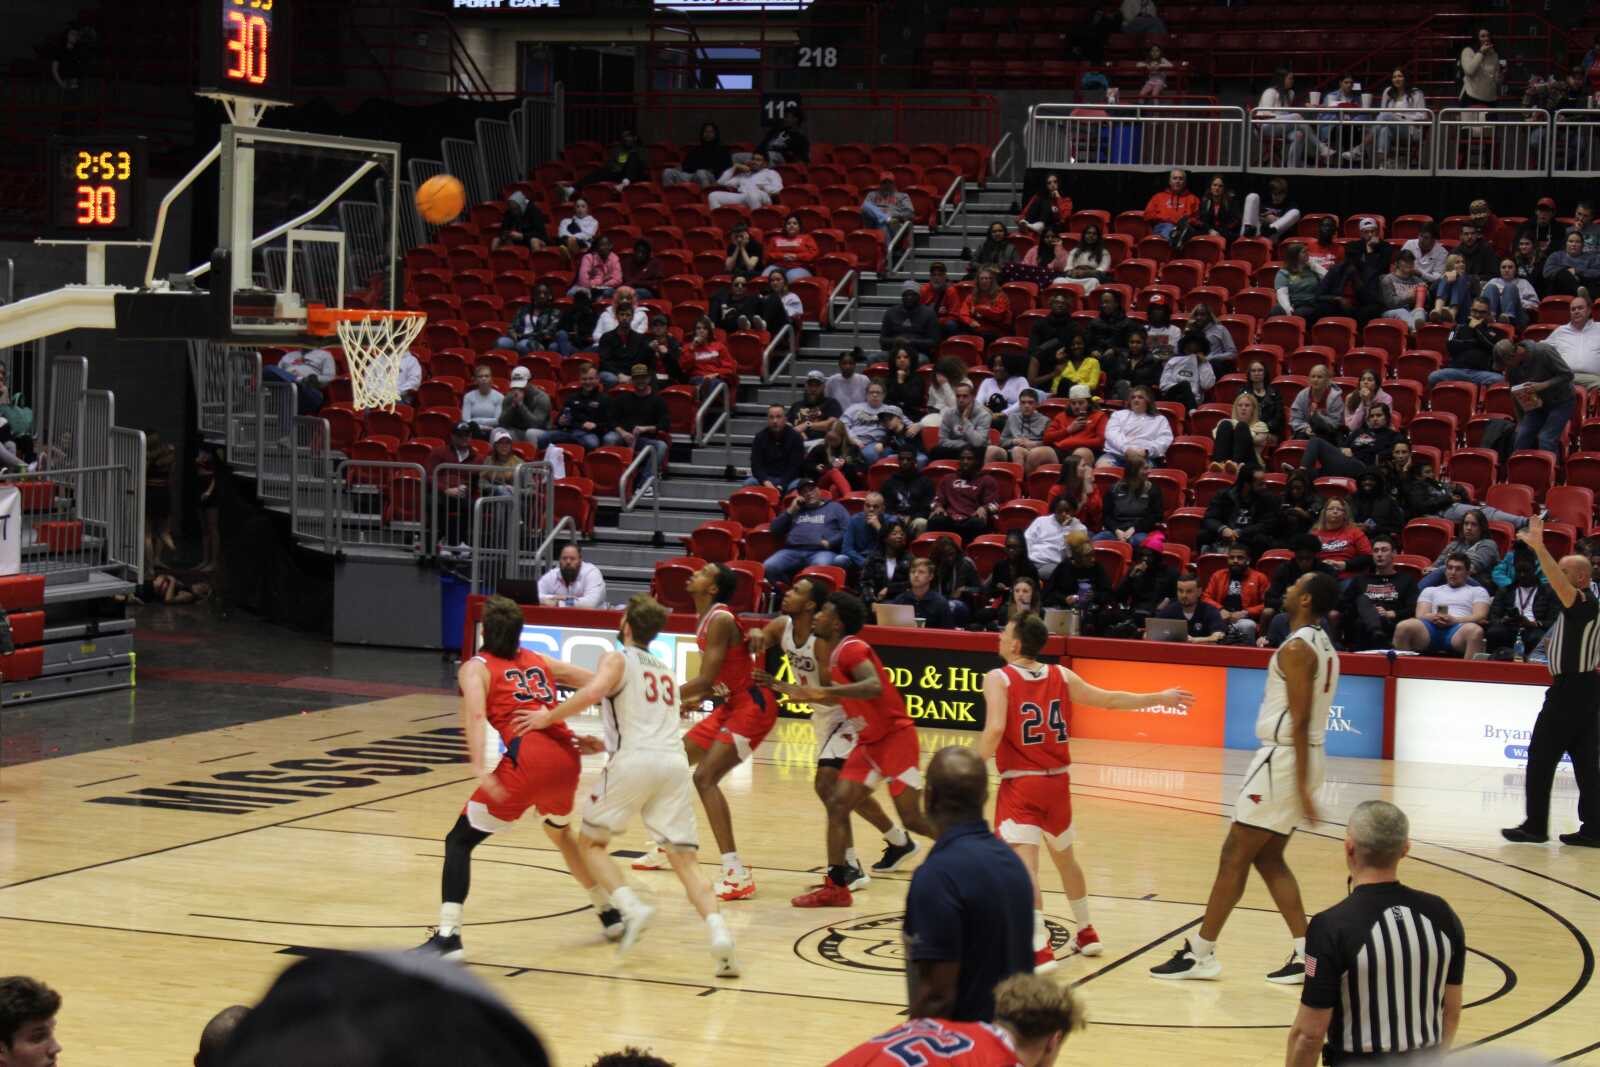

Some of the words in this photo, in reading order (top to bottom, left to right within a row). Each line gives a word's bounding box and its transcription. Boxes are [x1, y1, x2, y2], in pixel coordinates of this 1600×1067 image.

[228, 11, 267, 83] 30
[798, 47, 838, 68] 218
[76, 151, 131, 180] 2:53
[77, 185, 116, 224] 30
[506, 666, 553, 704] 33
[643, 671, 675, 706] 33
[920, 665, 943, 689] &
[905, 694, 977, 722] BANK
[1020, 699, 1069, 746] 24
[1483, 724, 1532, 744] Bryan
